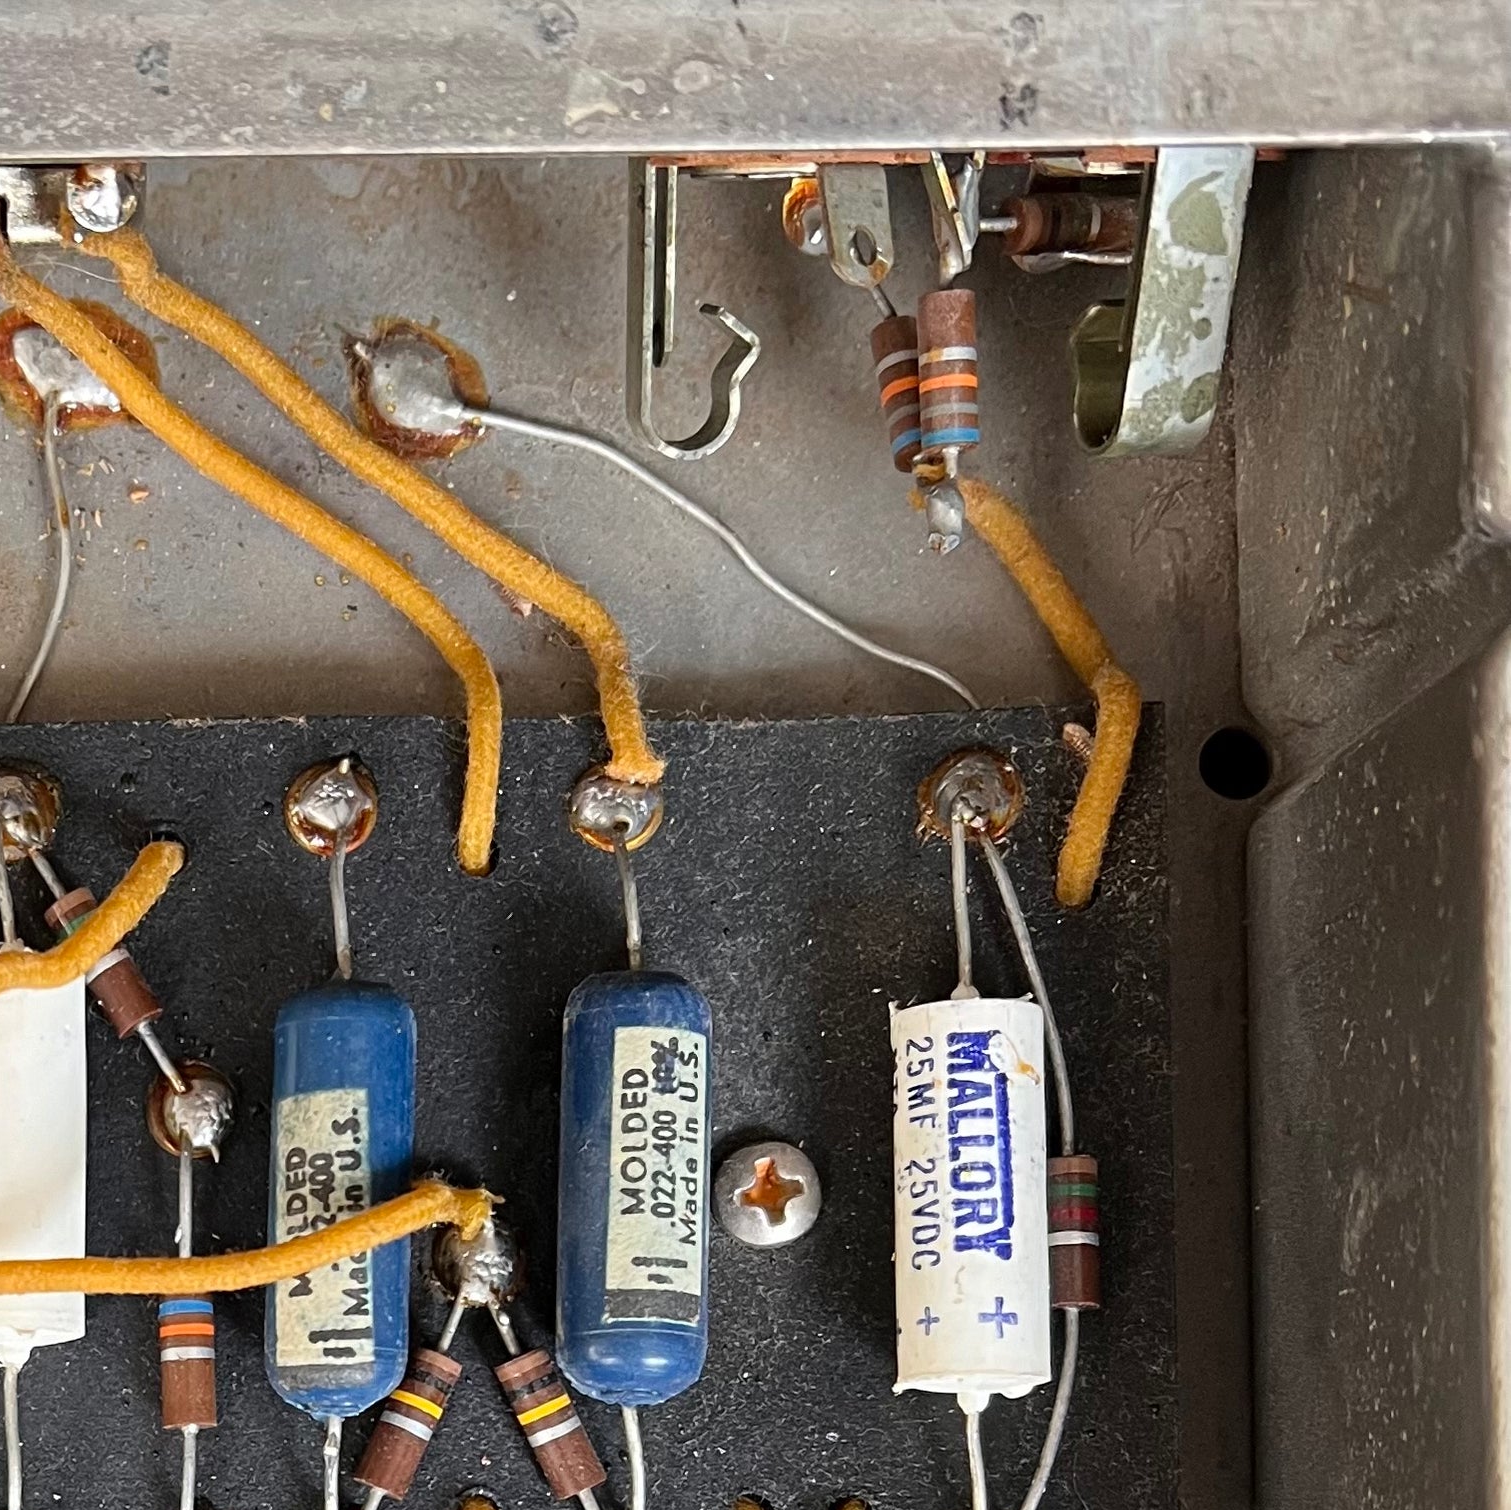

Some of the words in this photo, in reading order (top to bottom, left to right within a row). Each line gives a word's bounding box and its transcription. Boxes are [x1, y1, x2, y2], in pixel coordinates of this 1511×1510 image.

[678, 1042, 699, 1103] U.S.
[620, 1068, 649, 1215] MOLDED
[679, 1117, 699, 1144] in
[946, 1029, 1013, 1261] MALLORY
[285, 1147, 313, 1297] MLDED
[678, 1157, 698, 1246] Made
[341, 1252, 369, 1316] Ma
